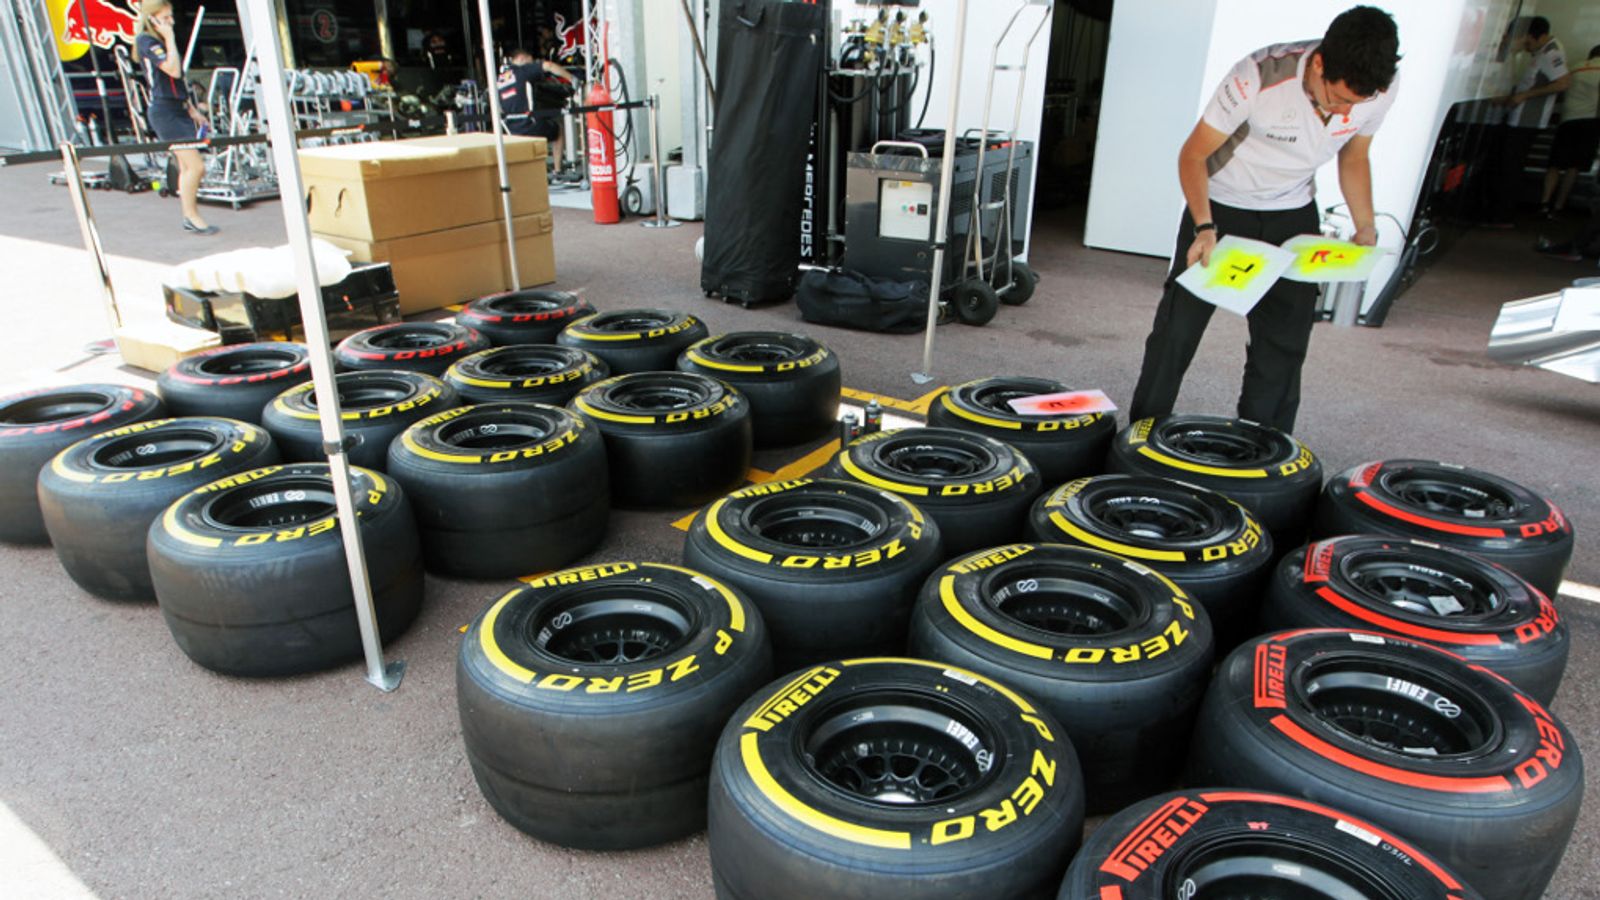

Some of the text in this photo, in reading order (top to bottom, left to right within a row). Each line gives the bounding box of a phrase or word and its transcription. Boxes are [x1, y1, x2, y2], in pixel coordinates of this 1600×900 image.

[649, 316, 696, 338] ZERO
[777, 348, 828, 372] ZERO
[523, 366, 592, 388] ZERO
[369, 388, 441, 418] ZERO
[666, 394, 740, 423] ZERO
[490, 430, 579, 463] ZERO
[101, 452, 221, 484] ZERO
[941, 466, 1024, 496] ZERO
[729, 479, 813, 498] PIRELLI
[233, 511, 362, 546] ERO
[782, 539, 906, 569] ZERO
[947, 544, 1034, 574] PIRELLI
[529, 562, 637, 588] PIRELLI
[1064, 620, 1188, 663] ZERO
[537, 629, 733, 694] P ZERO
[1254, 643, 1287, 708] PIRELLI
[743, 666, 841, 731] PIRELLI
[1513, 690, 1565, 789] ZERO
[931, 713, 1056, 845] P ZERO
[1100, 796, 1208, 881] PIRELLI
